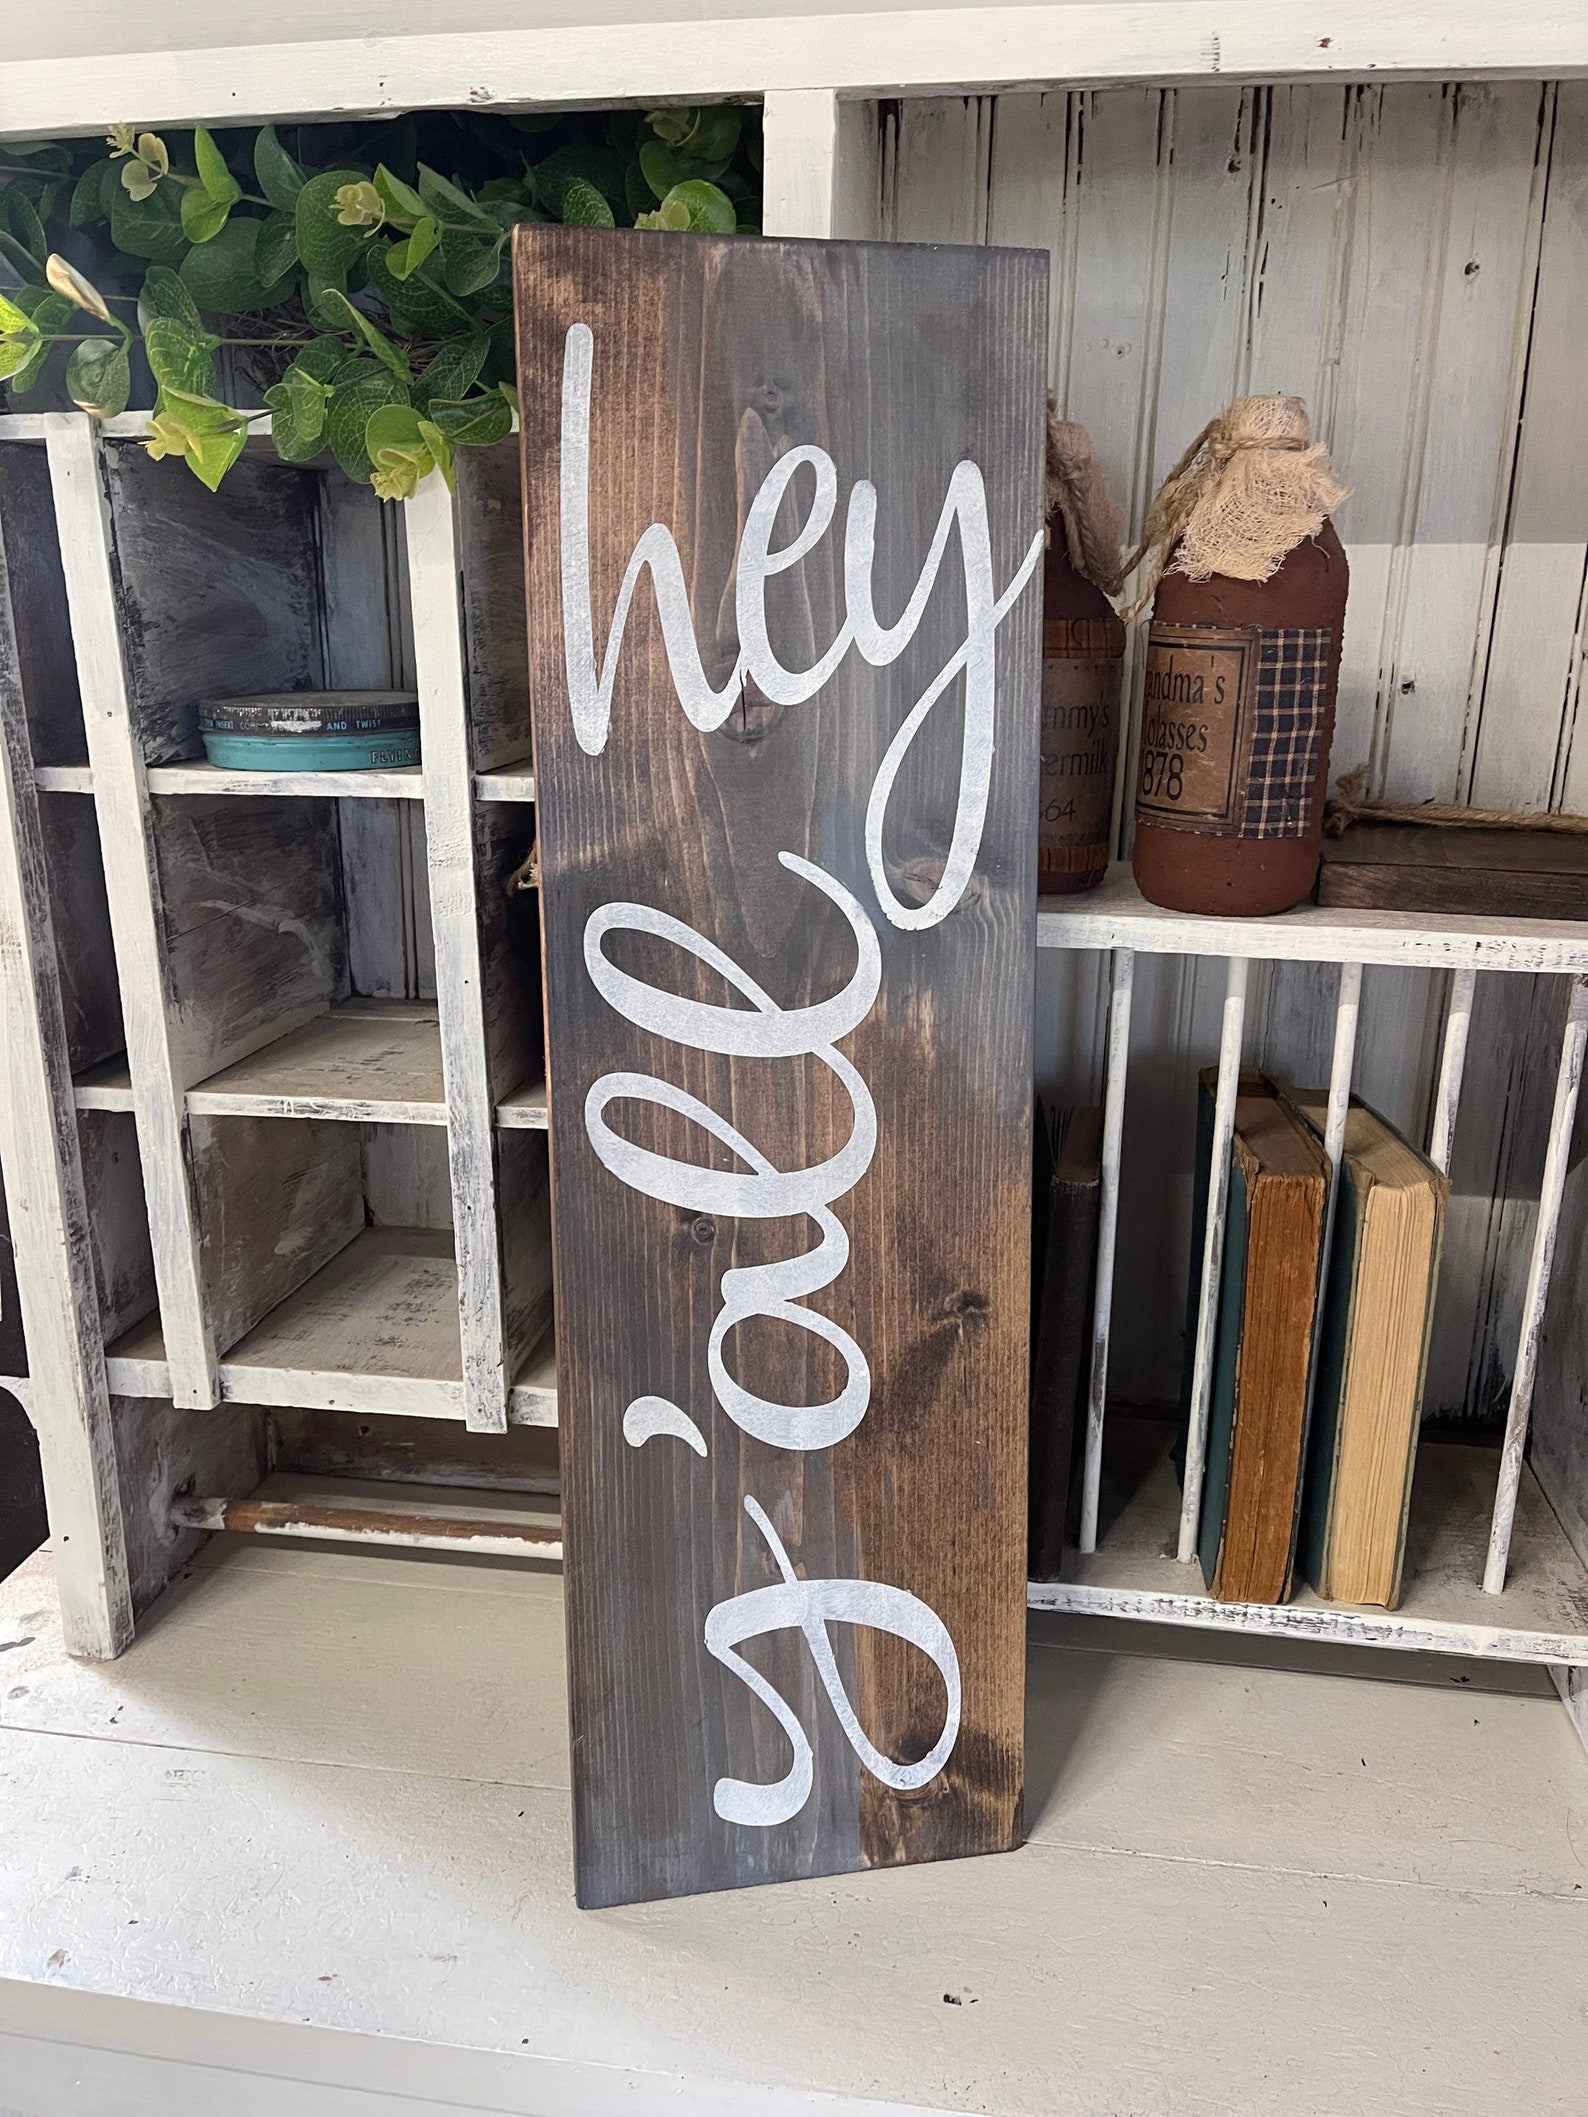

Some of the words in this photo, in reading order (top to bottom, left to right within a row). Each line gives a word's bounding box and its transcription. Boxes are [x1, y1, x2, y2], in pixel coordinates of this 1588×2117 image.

[559, 322, 1046, 931] hey
[1145, 654, 1226, 705] andma's
[326, 721, 348, 731] AND
[355, 719, 381, 730] TWIST
[1040, 738, 1108, 776] ermilk
[1039, 798, 1077, 822] 64
[582, 850, 962, 1828] y'all
